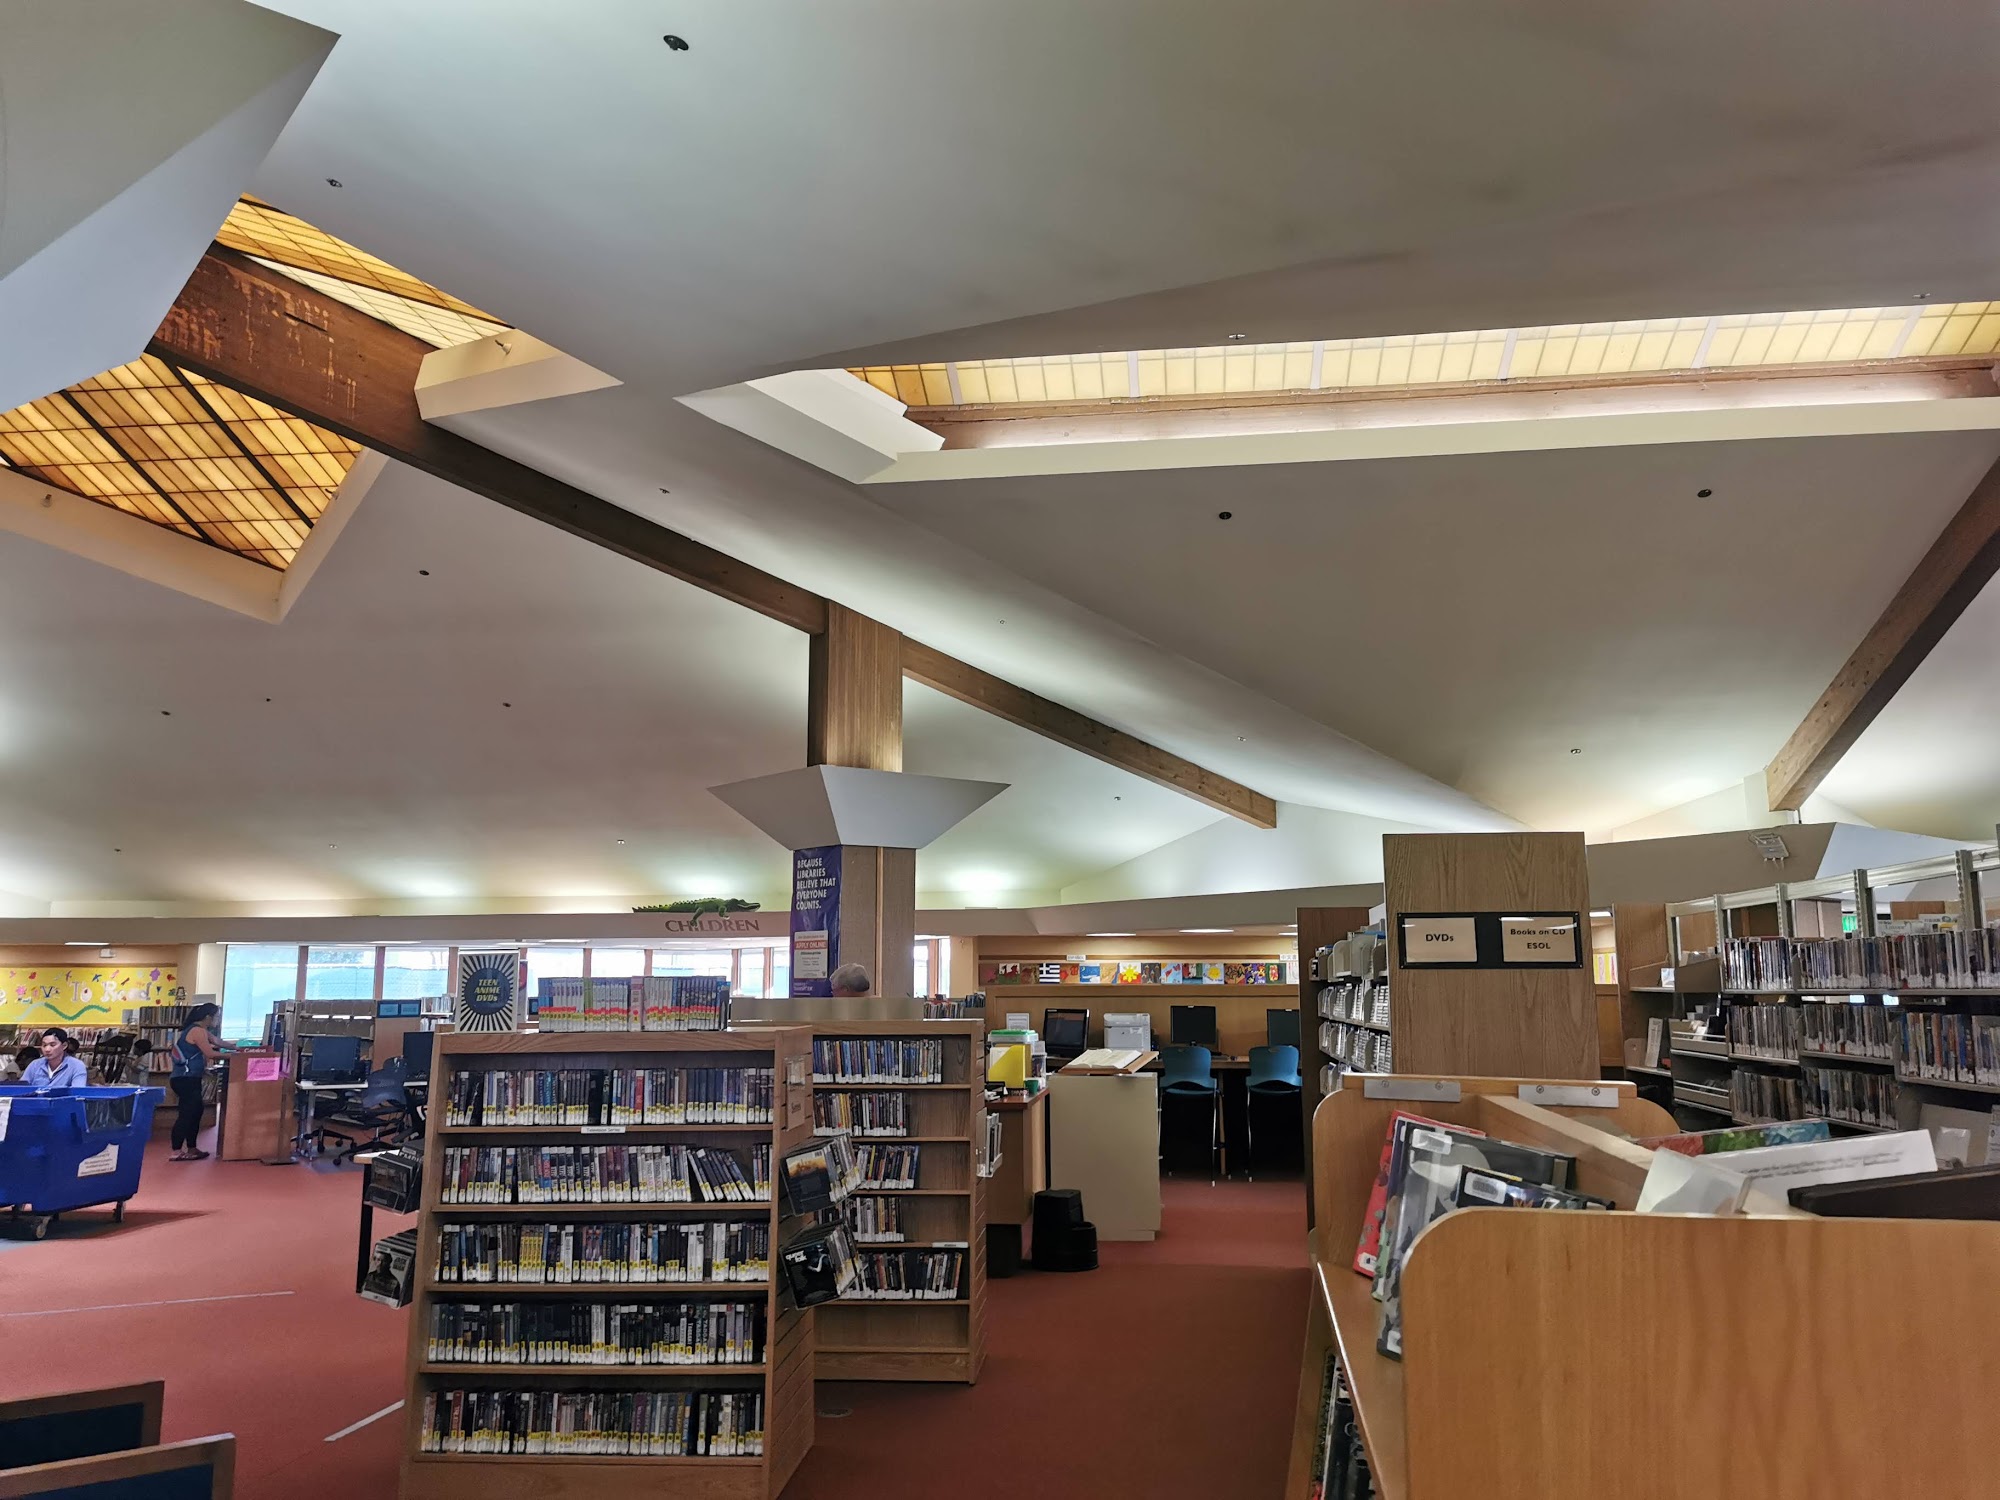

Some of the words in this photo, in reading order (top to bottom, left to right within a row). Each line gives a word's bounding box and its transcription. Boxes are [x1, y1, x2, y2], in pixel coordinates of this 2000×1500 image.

[797, 857, 823, 869] BECAUSE
[797, 868, 826, 879] LIBRARIES
[796, 879, 818, 890] BELIEVE
[820, 877, 836, 887] THAT
[796, 889, 827, 900] EVERYONE
[796, 900, 822, 910] COUNTS.
[1552, 928, 1566, 936] CD
[1425, 933, 1454, 942] DVDs
[1526, 942, 1551, 950] ESOL
[68, 981, 94, 1003] To
[474, 986, 501, 994] ANIME
[476, 994, 498, 1002] DVDs
